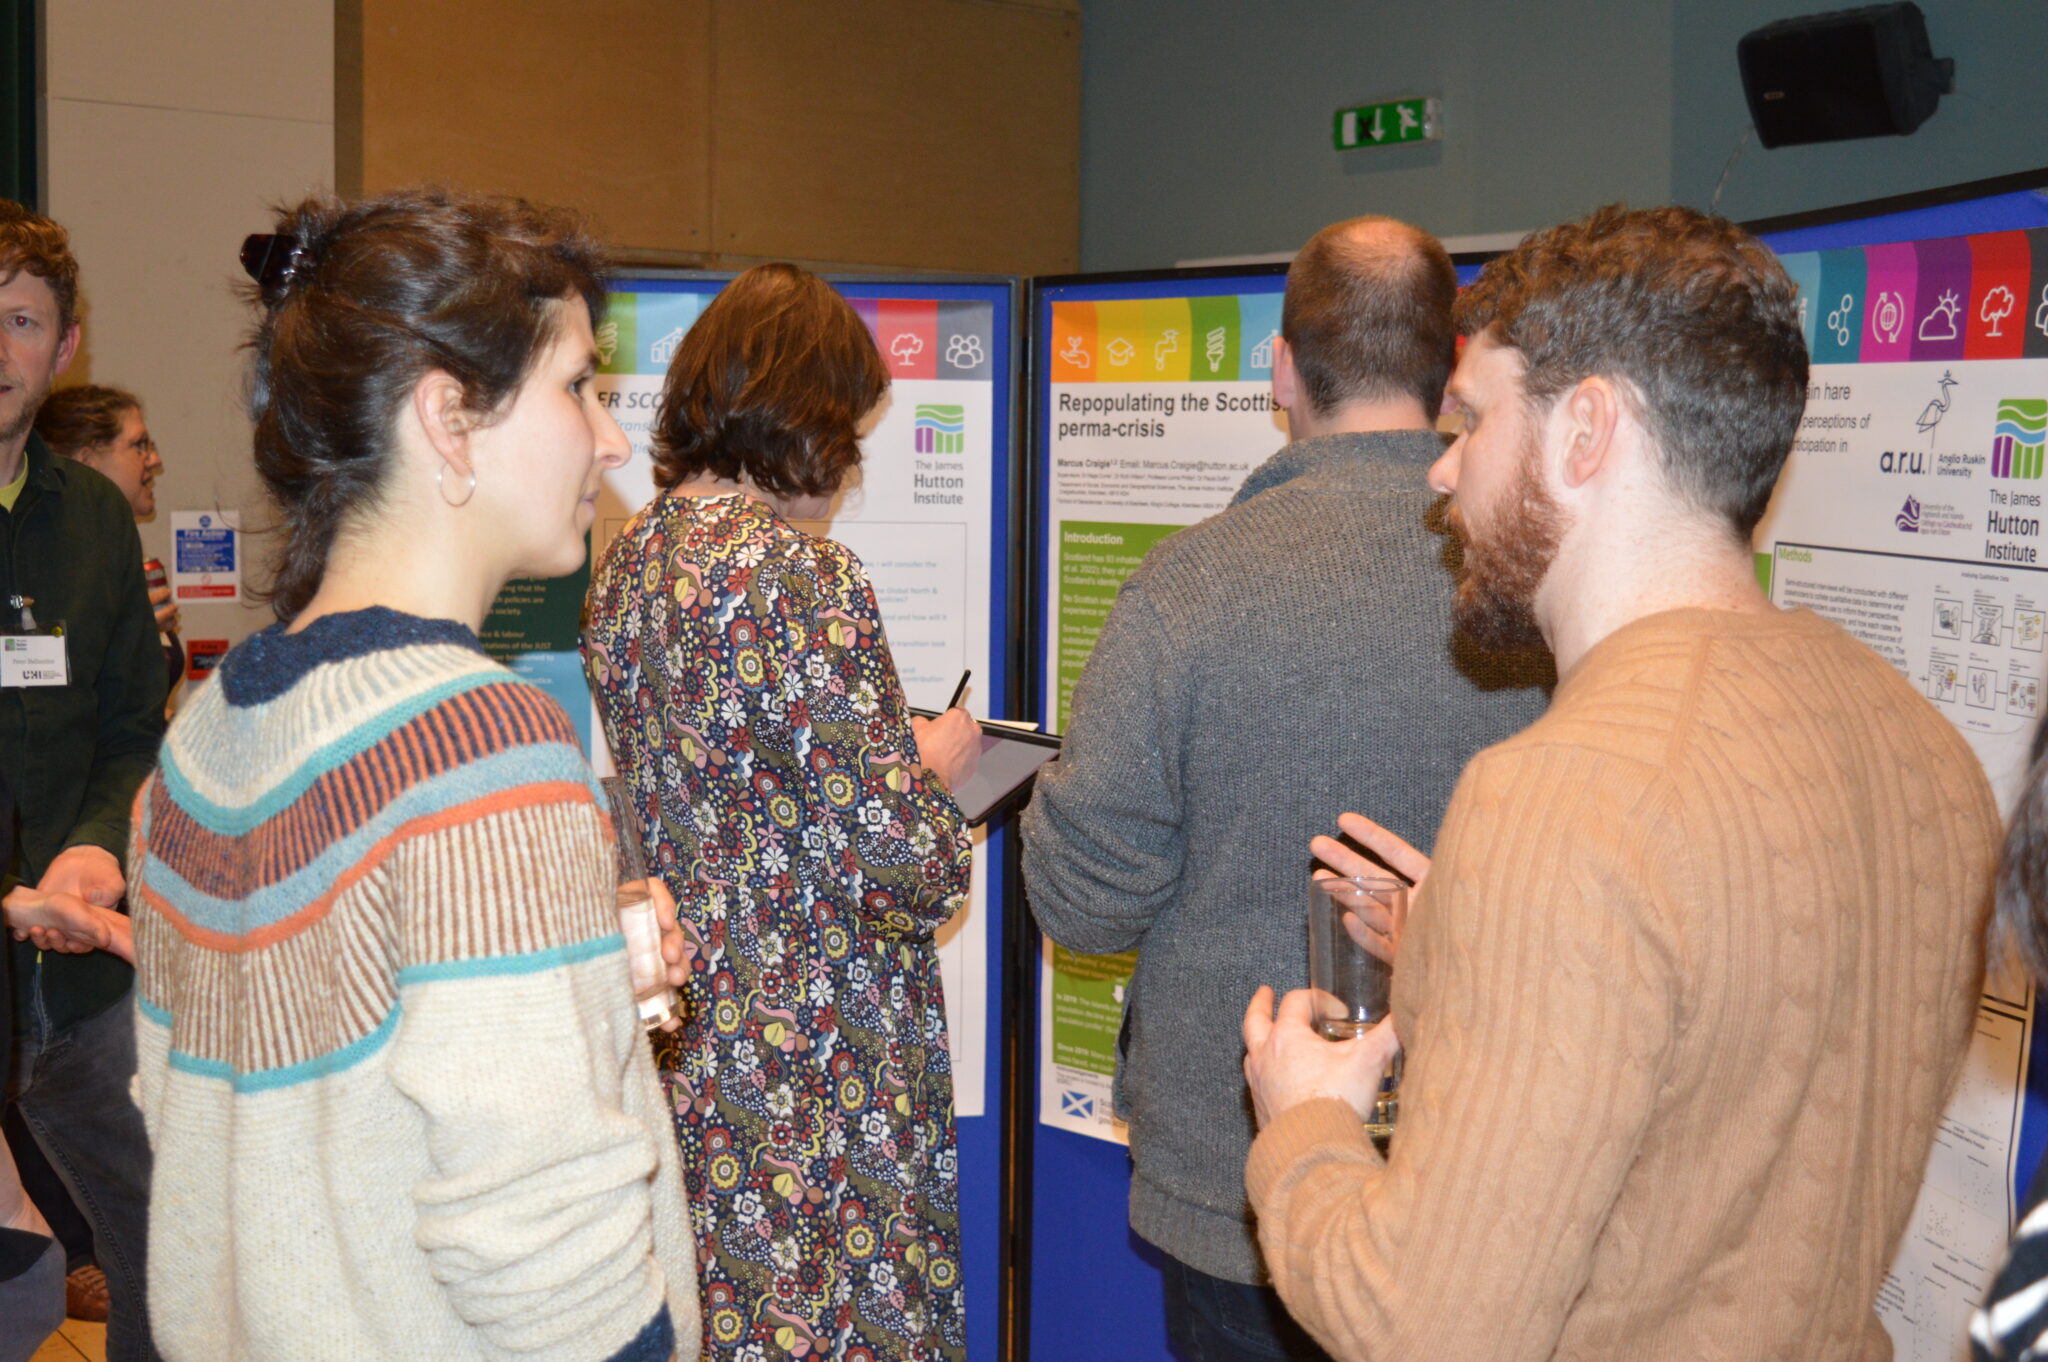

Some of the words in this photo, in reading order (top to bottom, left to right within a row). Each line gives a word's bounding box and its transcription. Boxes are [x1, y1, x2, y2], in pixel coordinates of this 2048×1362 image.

[1824, 381, 1850, 400] hare
[1059, 392, 1175, 416] Repopulating
[1181, 392, 1209, 411] the
[1216, 391, 1287, 411] Scottis
[1059, 418, 1165, 441] perma-crisis
[1802, 414, 1857, 431] perceptions
[1860, 412, 1872, 429] of
[1840, 438, 1848, 453] in
[914, 459, 933, 470] The
[934, 460, 964, 472] James
[1057, 458, 1083, 468] Marcus
[1880, 450, 1926, 475] a.r.u.
[1963, 453, 1986, 465] Ruskin
[1937, 466, 1972, 479] University
[914, 473, 964, 489] Hutton
[914, 491, 964, 505] Institute
[1990, 488, 2007, 505] The
[2010, 490, 2041, 508] James
[1987, 510, 2039, 537] Hutton
[1064, 531, 1124, 545] Introduction
[1779, 547, 1812, 563] Methods
[1985, 539, 2037, 563] Institute
